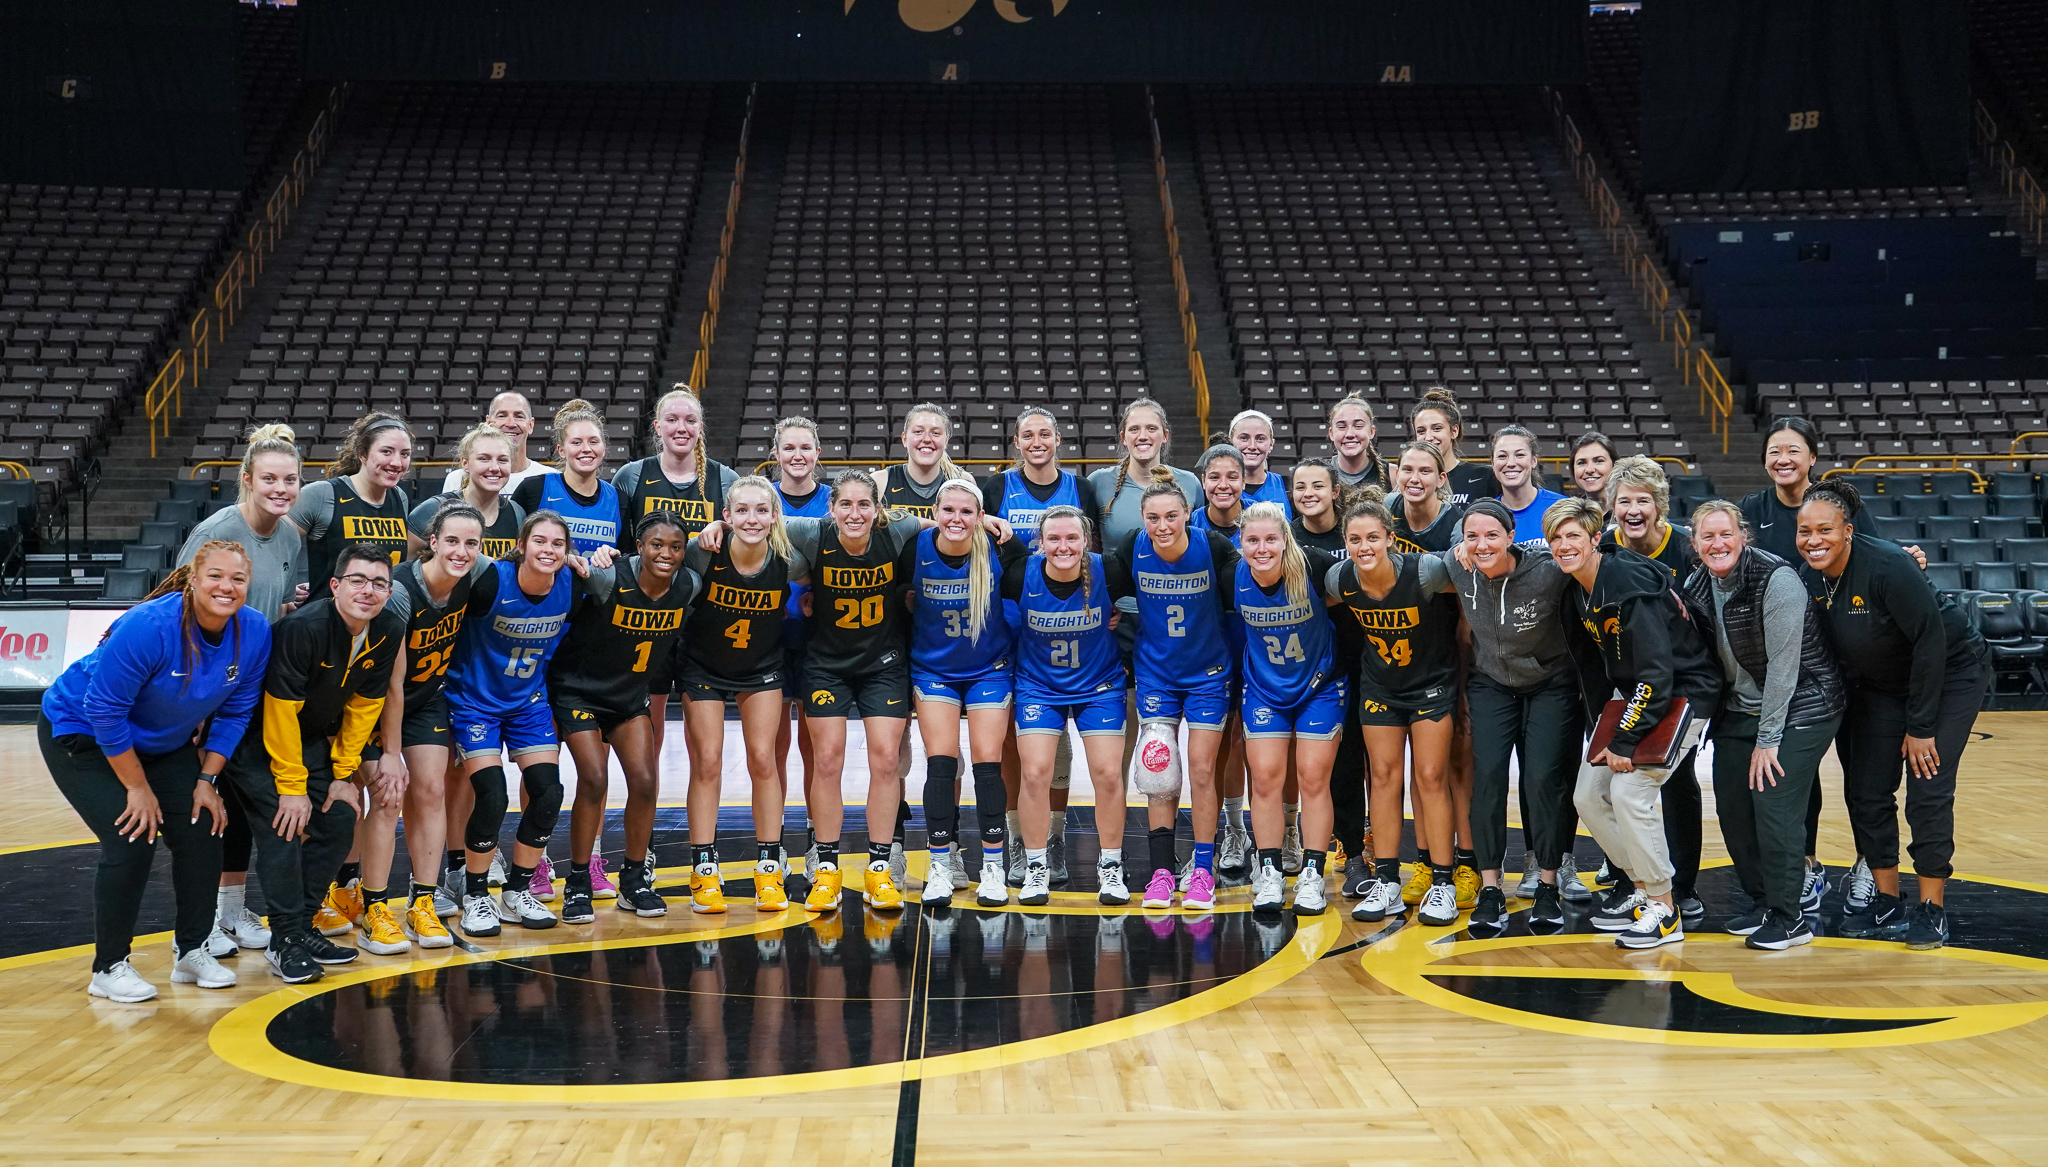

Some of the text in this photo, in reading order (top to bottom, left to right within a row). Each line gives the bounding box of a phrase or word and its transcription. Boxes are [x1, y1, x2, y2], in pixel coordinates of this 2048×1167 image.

[490, 62, 506, 79] B
[942, 63, 958, 80] A
[1380, 65, 1411, 82] AA
[61, 79, 77, 98] C
[1788, 110, 1819, 131] BB
[352, 518, 405, 538] IOWA
[566, 521, 616, 538] EIGHTON
[831, 567, 888, 587] IOWA
[1140, 575, 1208, 590] CREIGHTON
[715, 585, 773, 608] IOWA
[621, 608, 676, 629] IOWA
[834, 594, 885, 629] 20
[1029, 611, 1101, 628] CREIGHTON
[1166, 604, 1186, 637] 2
[1243, 604, 1311, 622] CREIGHTON
[1357, 610, 1412, 628] IOWA
[418, 610, 465, 648] IOWA
[496, 617, 567, 634] CREIGHTON
[724, 618, 752, 649] 4
[941, 609, 971, 638] 33
[632, 640, 653, 673] 1
[1050, 639, 1081, 669] 21
[1263, 632, 1306, 665] 24
[1367, 633, 1413, 667] 24
[504, 646, 544, 679] 15
[1619, 682, 1653, 731] HAWKEYES
